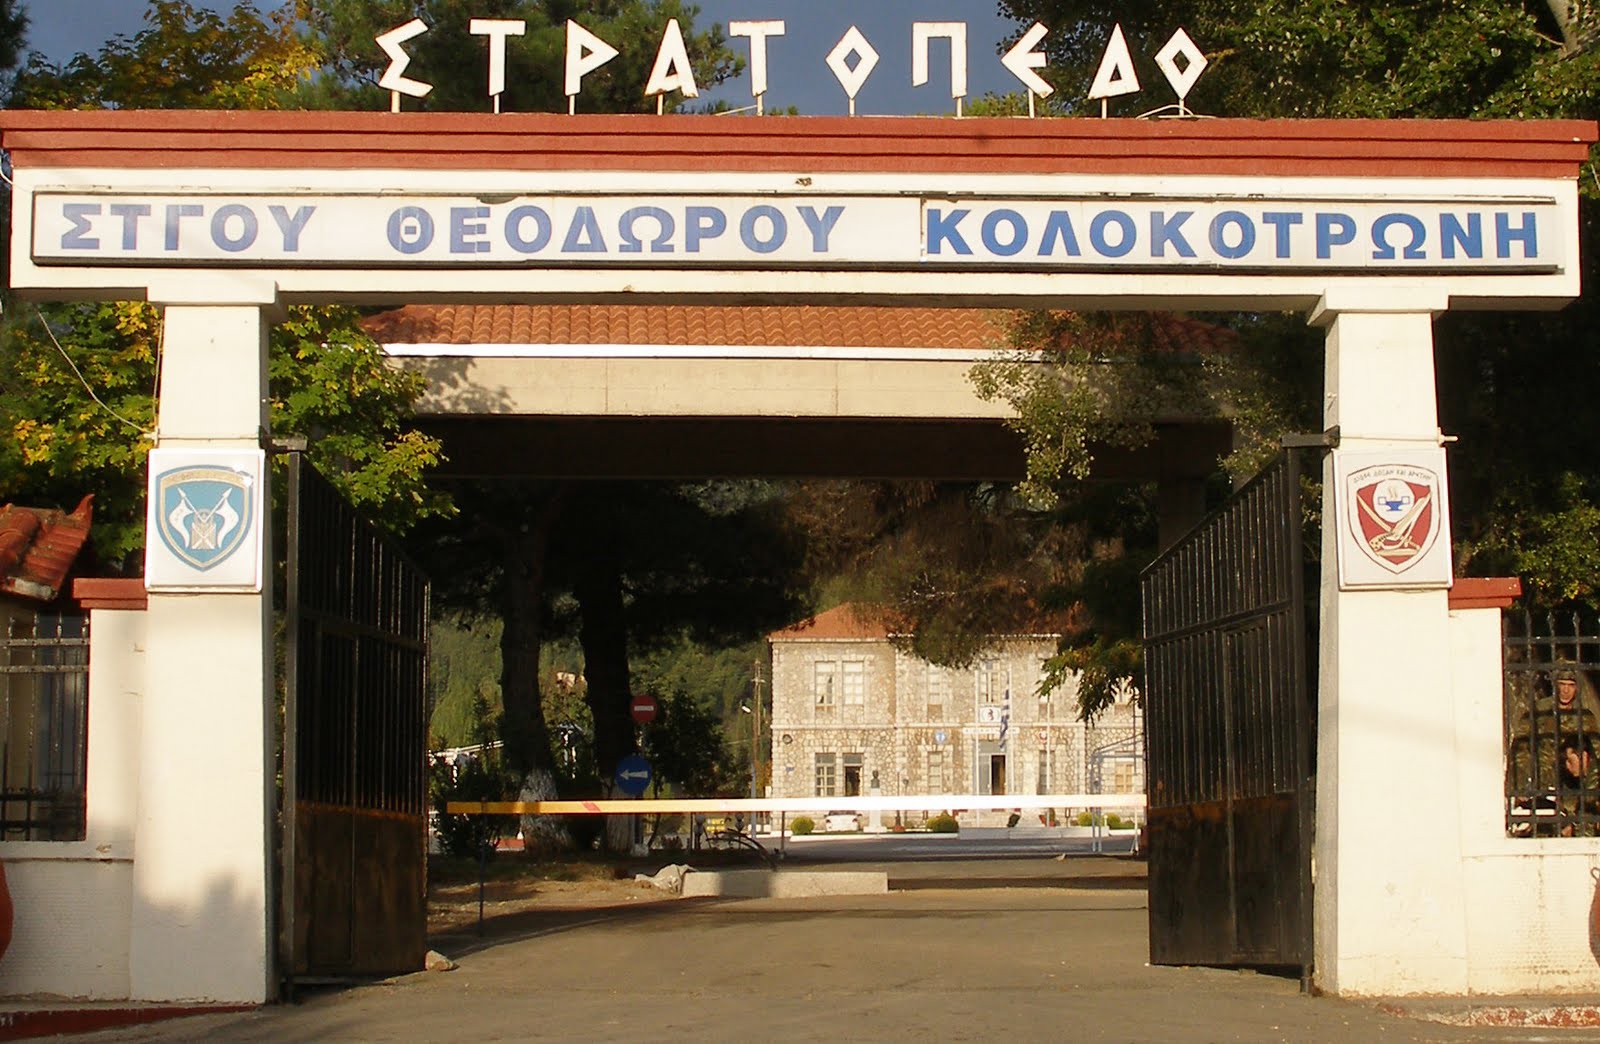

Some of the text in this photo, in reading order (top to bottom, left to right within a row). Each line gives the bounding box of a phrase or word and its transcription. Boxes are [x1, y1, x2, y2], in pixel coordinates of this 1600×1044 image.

[375, 17, 1209, 99] ΣΤΡΑΤΟΠΕΔΟ
[61, 203, 1539, 260] ΣΤΓΟΥ ΘΕΟΔΩΡΟΥ ΚΟΛΟΚΟΤΡΩΝΗ
